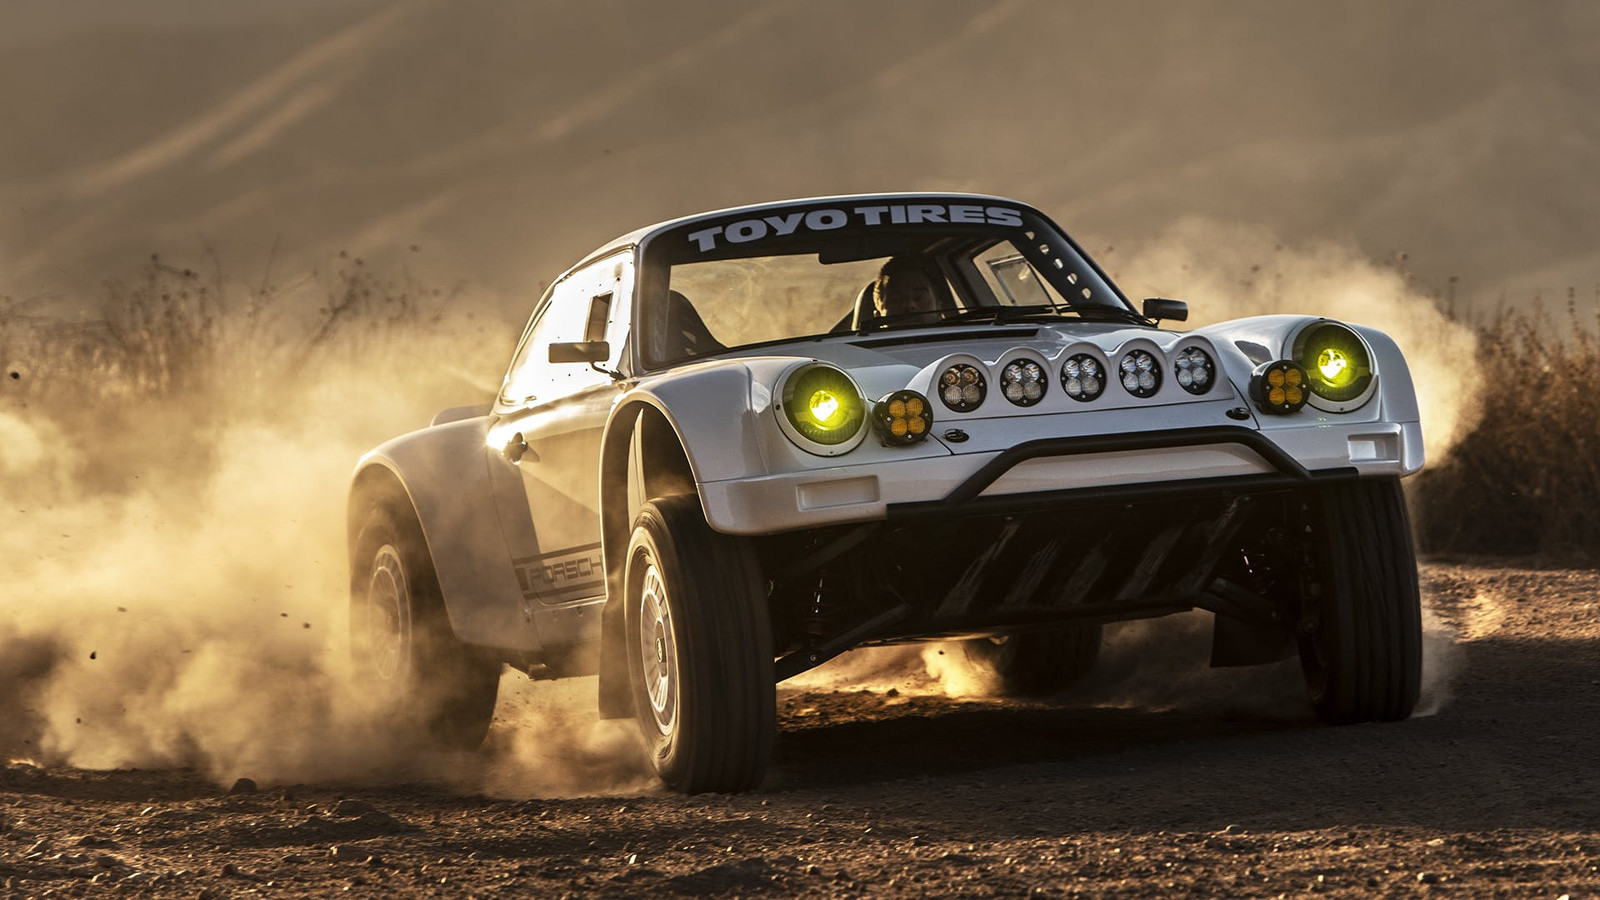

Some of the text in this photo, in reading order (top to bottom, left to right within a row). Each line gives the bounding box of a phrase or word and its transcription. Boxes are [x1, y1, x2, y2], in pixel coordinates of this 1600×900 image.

[688, 204, 1023, 252] TOYO TIRES
[529, 555, 604, 585] PORSCH
